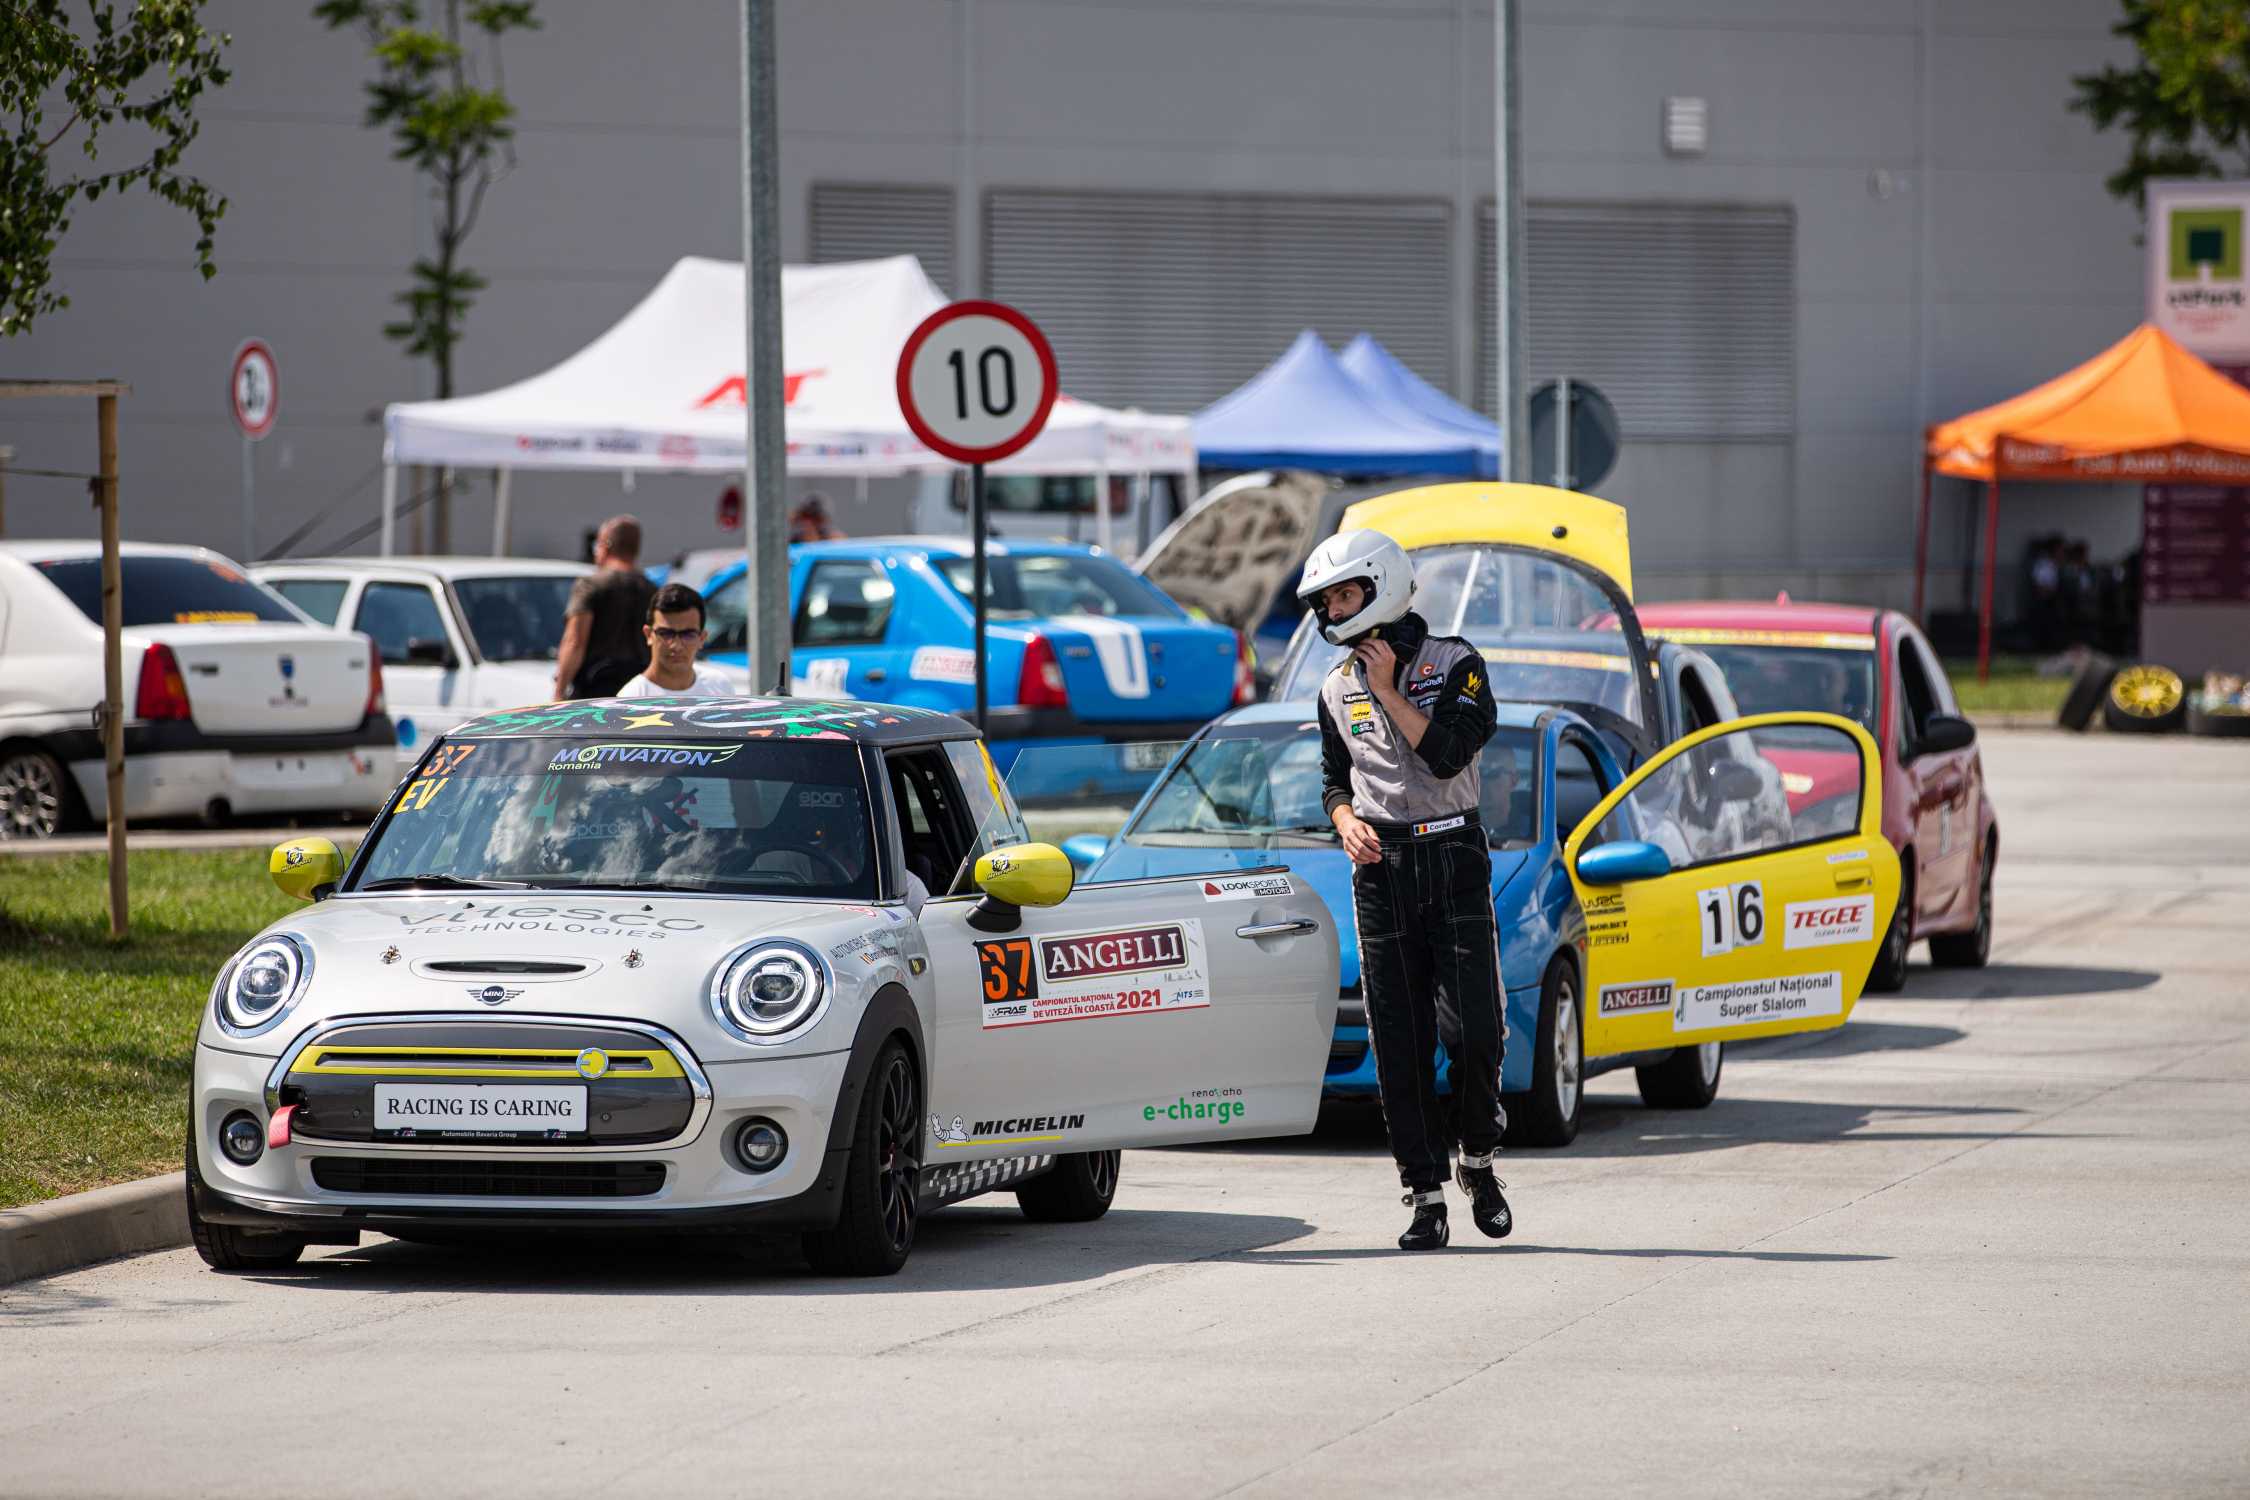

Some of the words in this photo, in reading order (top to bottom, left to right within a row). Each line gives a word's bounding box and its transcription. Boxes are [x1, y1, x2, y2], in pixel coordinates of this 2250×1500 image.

[948, 345, 1017, 419] 10
[547, 760, 602, 772] Romania
[551, 745, 714, 767] MOTIVATION
[393, 777, 449, 814] EV
[1259, 886, 1290, 896] MOTORS
[1707, 884, 1763, 945] 16
[1793, 903, 1867, 929] TEGEE
[406, 920, 667, 940] TECHNOLOGIES
[1049, 932, 1183, 974] ANGELLI
[981, 941, 1032, 1000] 37
[482, 990, 505, 998] MINI
[1032, 996, 1080, 1007] CAMPIONATUL
[1116, 988, 1161, 1010] 2021
[1604, 986, 1672, 1010] ANGELLI
[1695, 982, 1776, 1003] Campionatul
[1033, 1010, 1043, 1018] DE
[1720, 1000, 1758, 1018] Super
[1762, 996, 1807, 1013] Slalom
[387, 1098, 464, 1116] RACING
[469, 1099, 489, 1116] IS
[494, 1100, 573, 1117] CARING
[1143, 1096, 1245, 1125] e-charge
[972, 1113, 1085, 1136] MICHELIN
